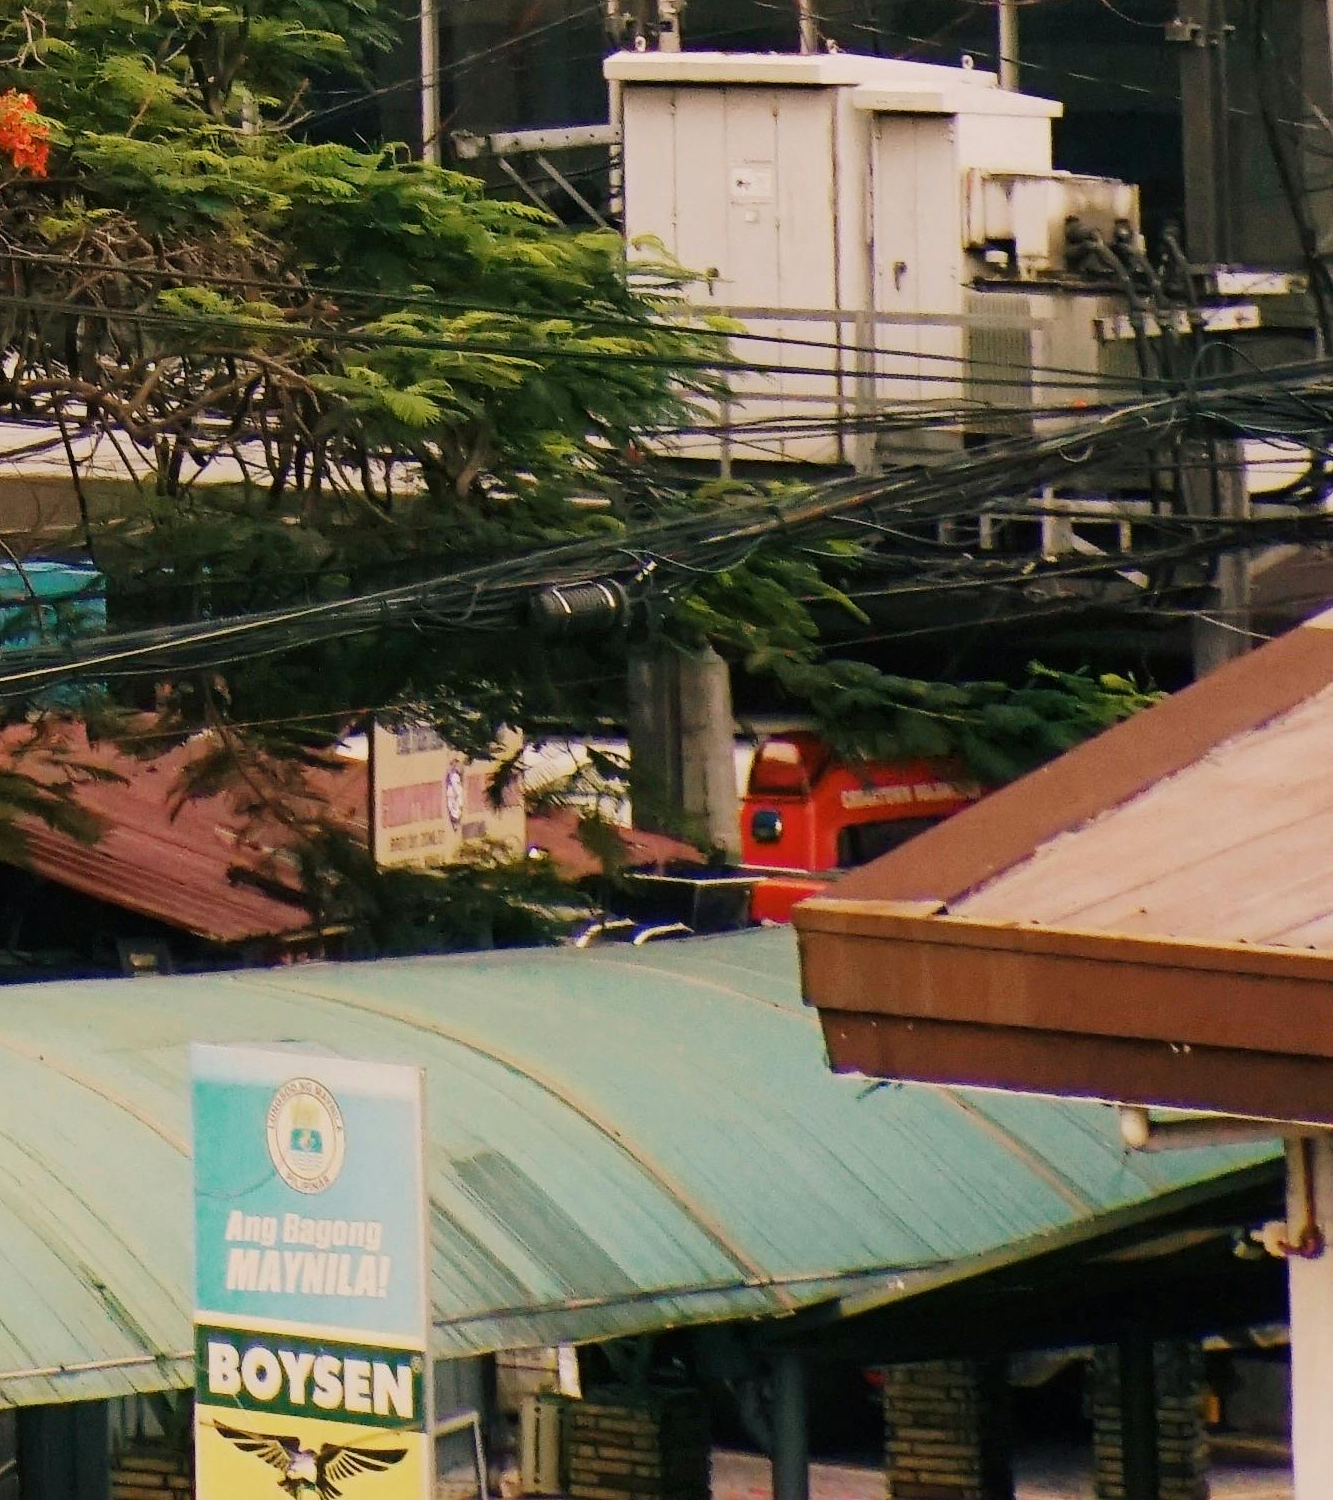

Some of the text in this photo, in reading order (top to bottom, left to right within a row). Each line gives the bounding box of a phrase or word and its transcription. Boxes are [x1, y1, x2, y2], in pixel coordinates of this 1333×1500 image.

[225, 1209, 383, 1250] Ang Bagong
[226, 1248, 391, 1298] MAYNILA!
[207, 1341, 413, 1418] BOYSEN
